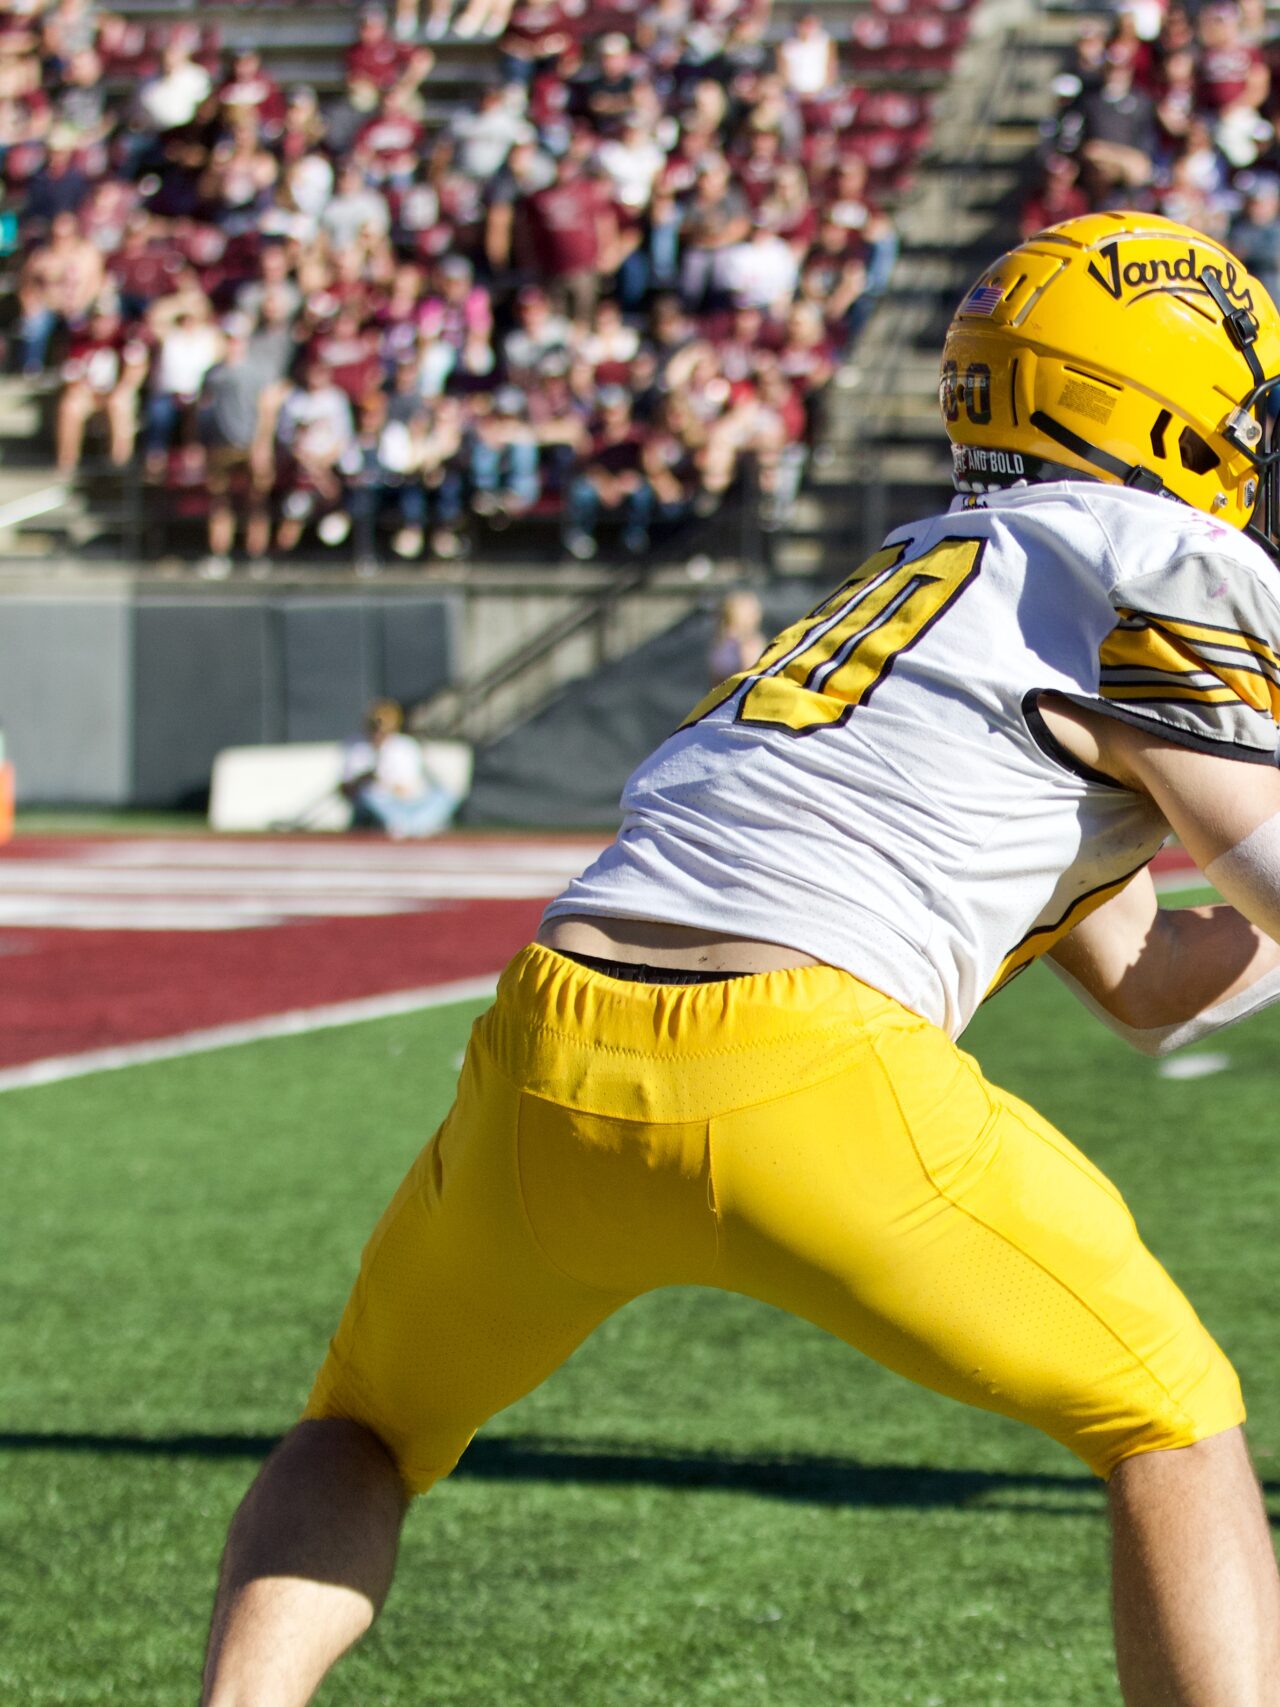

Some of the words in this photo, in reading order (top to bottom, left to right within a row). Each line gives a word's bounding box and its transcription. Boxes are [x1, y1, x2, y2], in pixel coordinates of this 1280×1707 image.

[1087, 241, 1259, 331] Vandals
[968, 449, 987, 471] AND
[989, 451, 1025, 475] BOLD
